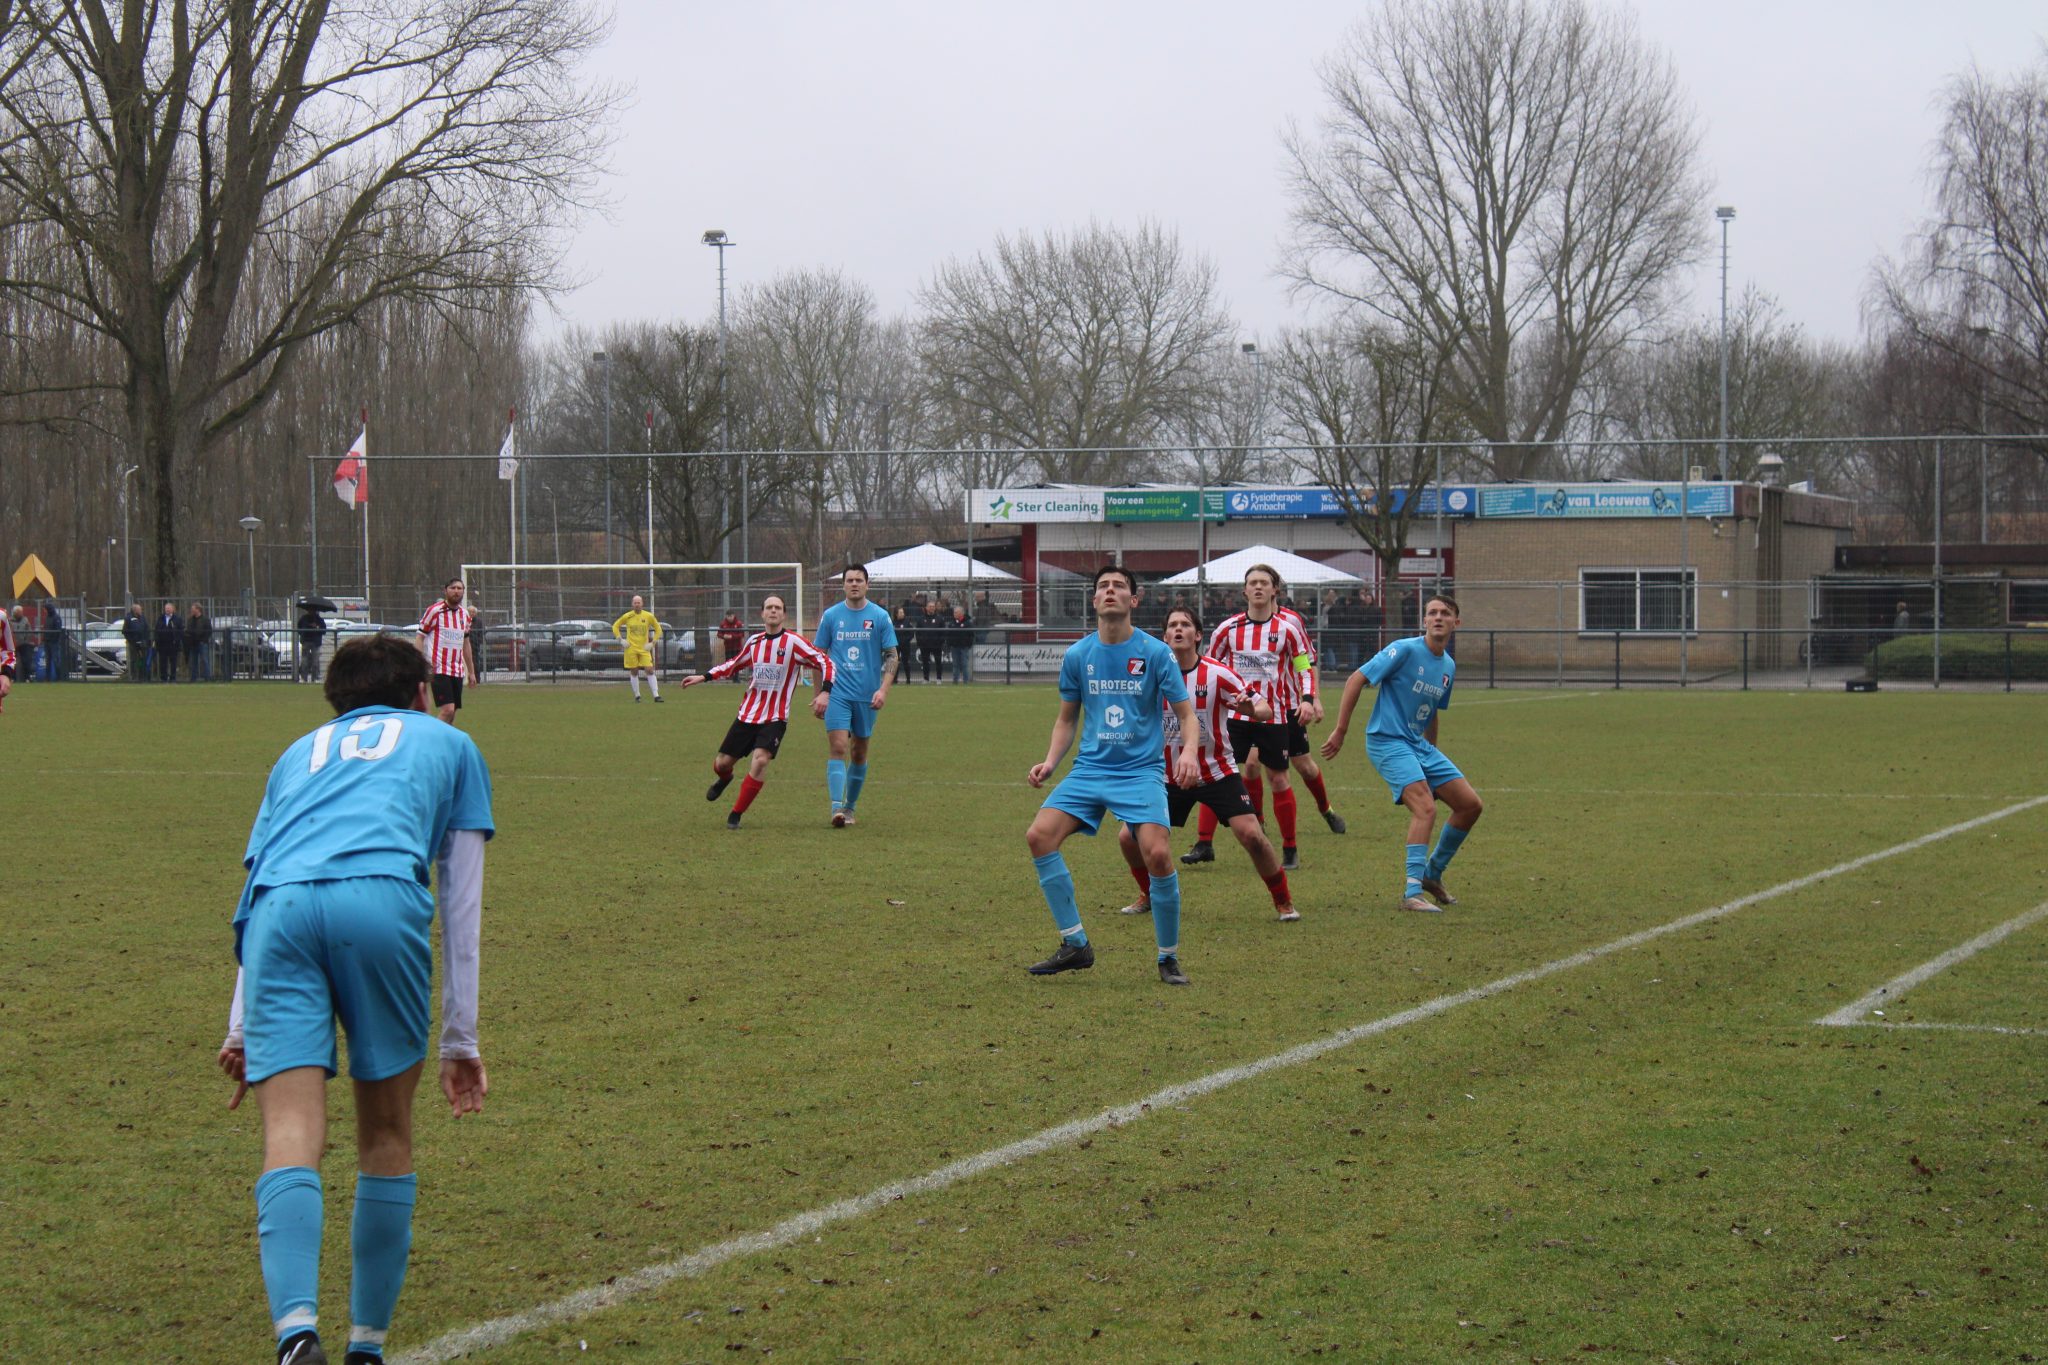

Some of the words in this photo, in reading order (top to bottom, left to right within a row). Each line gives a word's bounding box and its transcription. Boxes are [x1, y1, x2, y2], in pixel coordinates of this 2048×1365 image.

[1106, 496, 1126, 505] Voor
[1250, 492, 1303, 504] Fysiotherapie
[1567, 496, 1591, 507] van
[1594, 492, 1650, 507] Leeuwen
[1016, 502, 1042, 512] Ster
[1045, 500, 1098, 514] Cleaning
[1250, 502, 1286, 511] Ambacht
[1100, 680, 1142, 691] ROTECK
